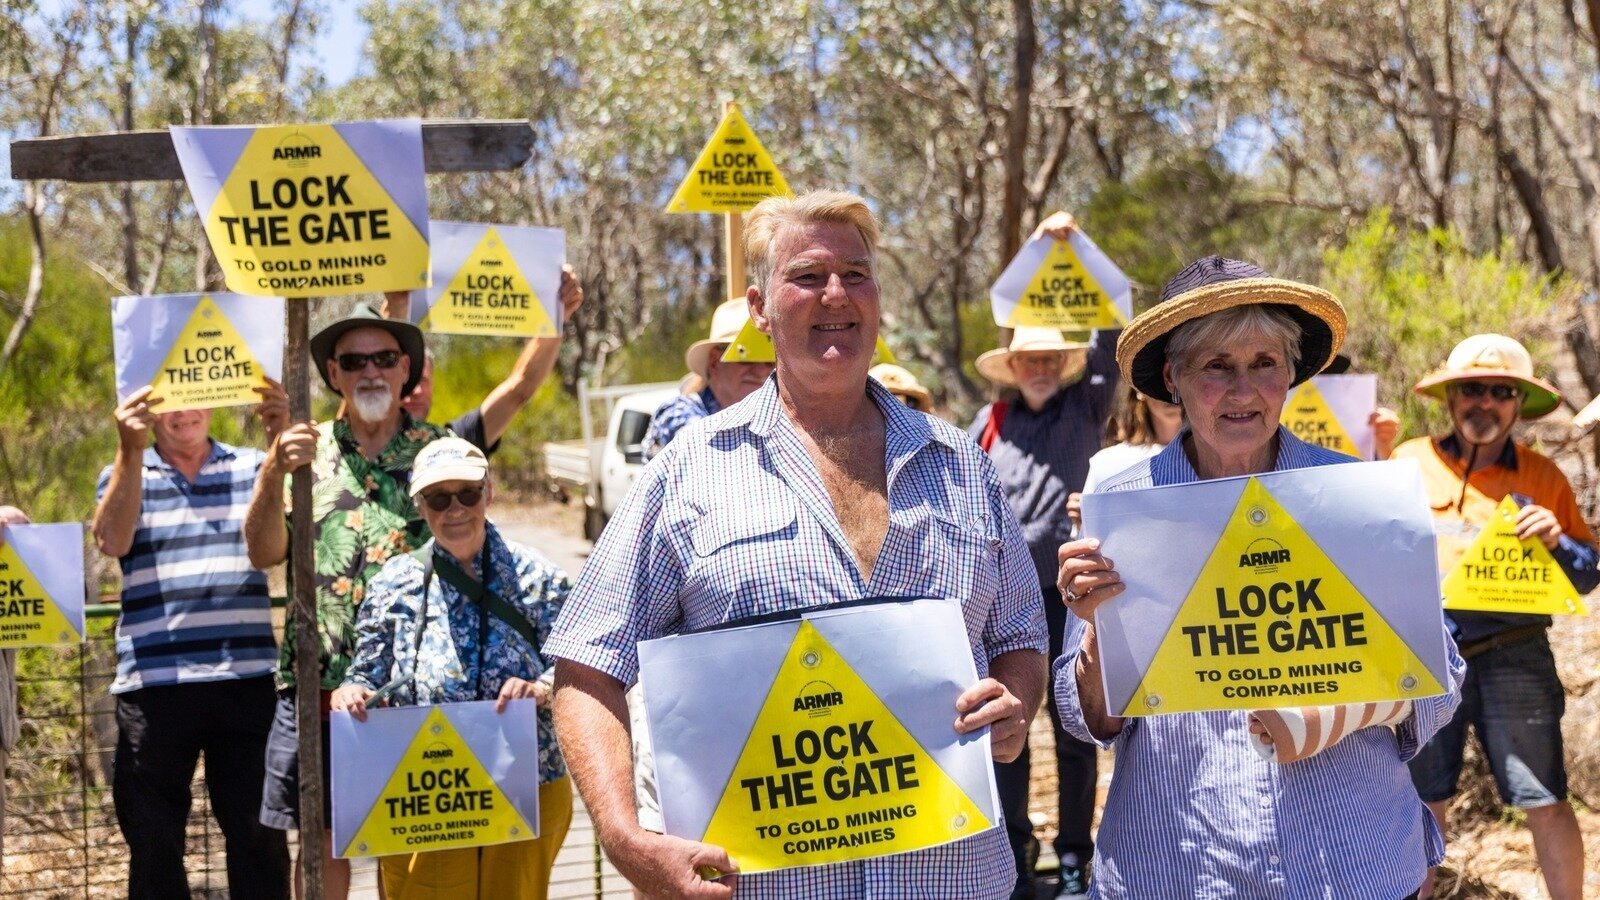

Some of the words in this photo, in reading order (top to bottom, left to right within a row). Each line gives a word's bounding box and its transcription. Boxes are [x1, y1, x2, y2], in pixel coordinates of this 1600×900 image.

[272, 146, 321, 160] ARMR
[713, 153, 757, 168] LOCK
[698, 170, 729, 185] THE
[733, 171, 773, 186] GATE
[250, 175, 353, 211] LOCK
[219, 215, 291, 246] THE
[300, 209, 391, 244] GATE
[234, 259, 255, 271] TO
[262, 257, 311, 272] GOLD
[319, 254, 386, 270] MINING
[258, 274, 364, 289] COMPANIES
[467, 275, 514, 291] LOCK
[1041, 278, 1083, 291] LOCK
[450, 292, 483, 307] THE
[488, 293, 530, 309] GATE
[1028, 294, 1056, 308] THE
[1062, 293, 1099, 307] GATE
[184, 345, 236, 364] LOCK
[165, 367, 203, 384] THE
[208, 361, 252, 380] GATE
[1239, 549, 1291, 567] ARMR
[1482, 546, 1534, 563] LOCK
[1464, 565, 1499, 580] THE
[1505, 566, 1552, 583] GATE
[1215, 578, 1326, 619] LOCK
[1, 623, 41, 632] MINING
[1182, 623, 1260, 657] THE
[1267, 613, 1368, 653] GATE
[0, 633, 27, 641] NIES
[1195, 670, 1222, 683] TO
[1228, 667, 1281, 681] GOLD
[1288, 660, 1363, 678] MINING
[1222, 680, 1339, 699] COMPANIES
[793, 692, 843, 712] ARMR
[771, 720, 879, 768] LOCK
[422, 749, 453, 760] ARMR
[407, 768, 471, 792] LOCK
[741, 770, 817, 811] THE
[823, 754, 920, 801] GATE
[385, 795, 430, 819] THE
[435, 790, 493, 814] GATE
[391, 827, 406, 836] TO
[411, 823, 442, 833] GOLD
[447, 818, 490, 829] MINING
[756, 825, 782, 839] TO
[787, 817, 839, 835] GOLD
[846, 804, 917, 828] MINING
[406, 831, 475, 845] COMPANIES
[783, 827, 896, 855] COMPANIES
